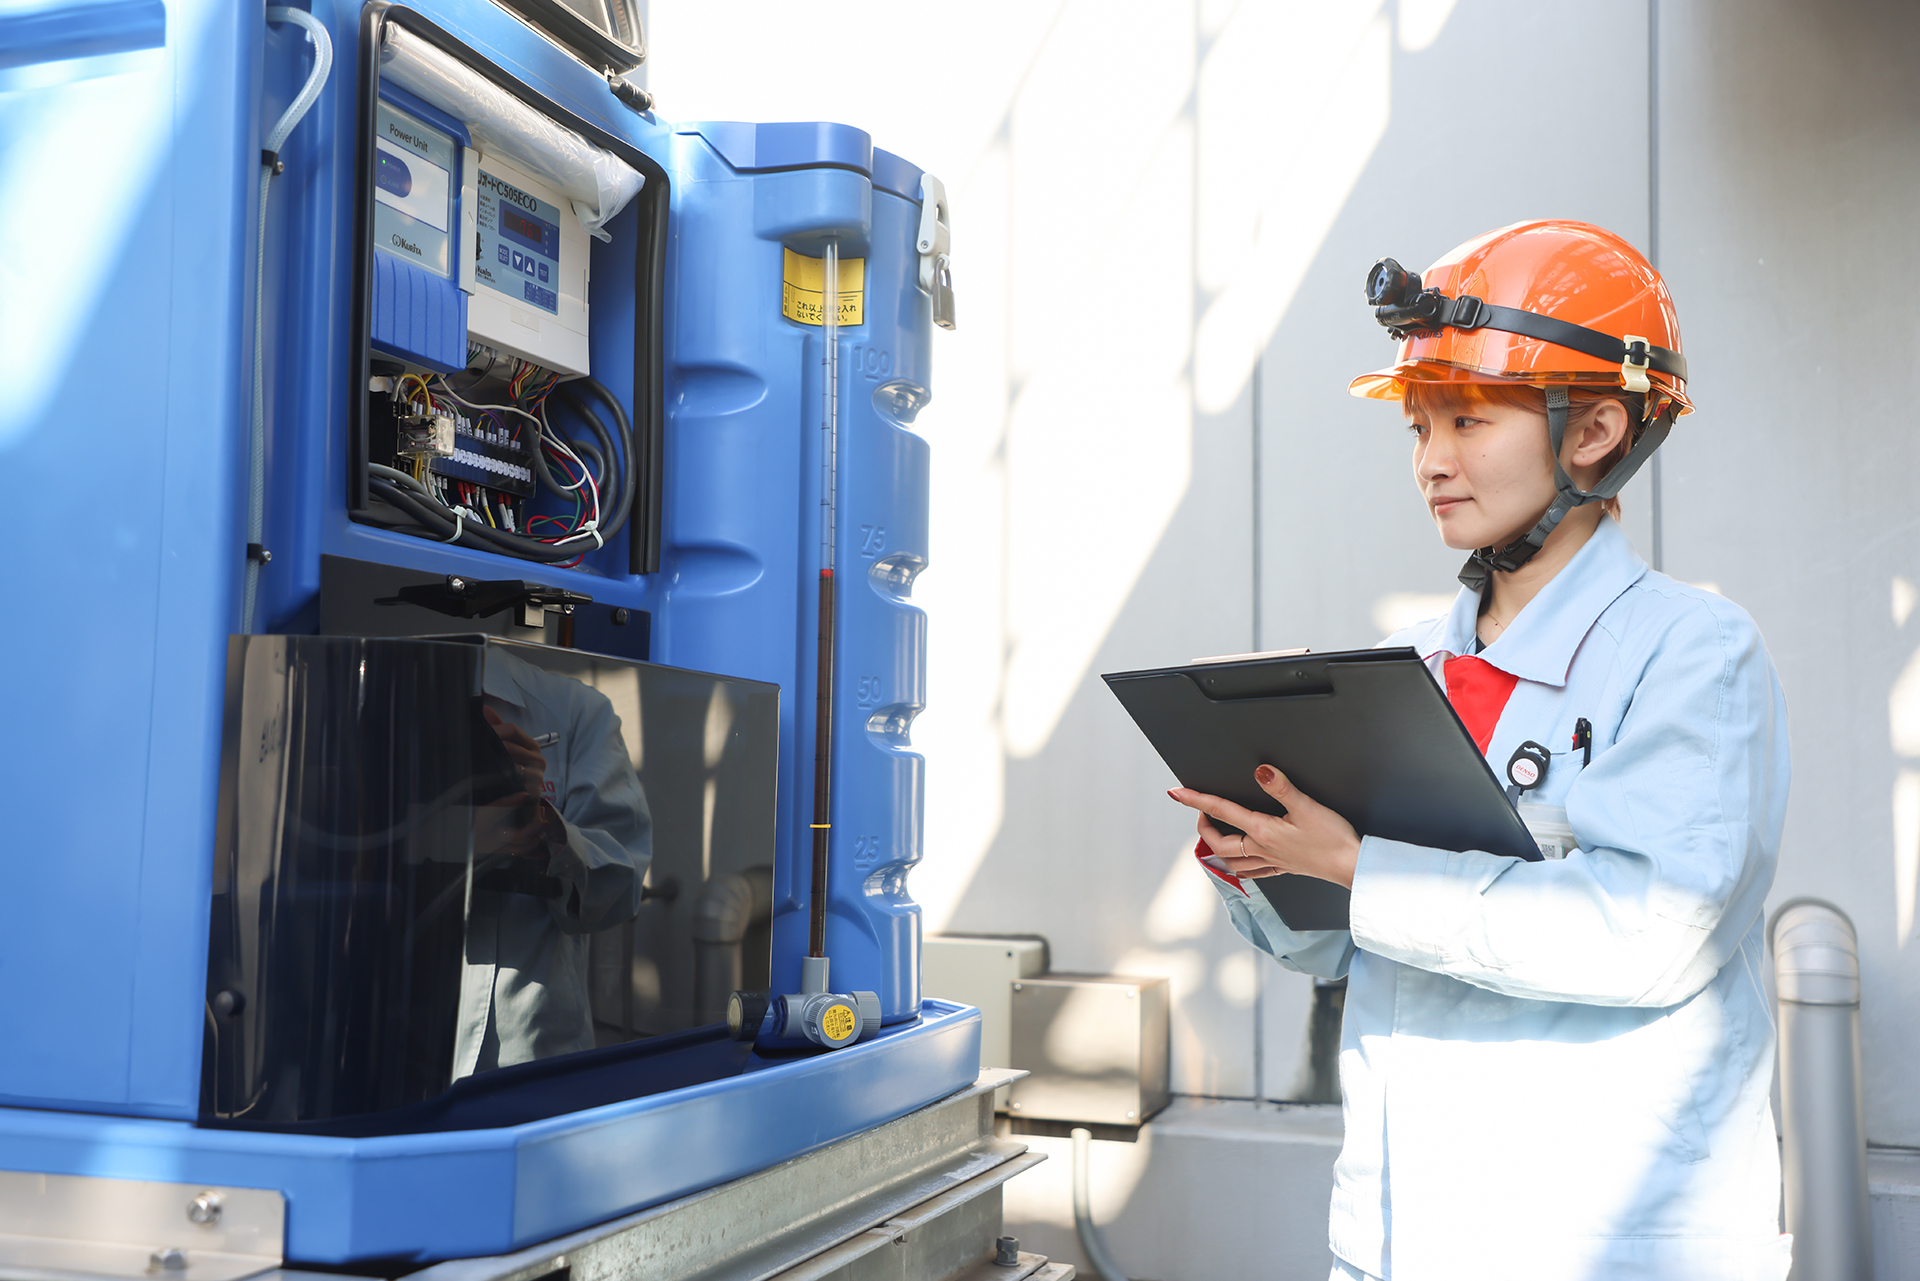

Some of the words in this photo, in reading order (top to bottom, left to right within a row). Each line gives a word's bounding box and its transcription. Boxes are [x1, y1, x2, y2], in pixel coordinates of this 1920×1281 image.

[389, 123, 412, 144] Power
[413, 135, 428, 153] Unit
[853, 345, 890, 377] 100
[861, 524, 886, 552] 75
[857, 675, 882, 702] 50
[1516, 765, 1535, 777] DENSO
[854, 834, 881, 862] 25
